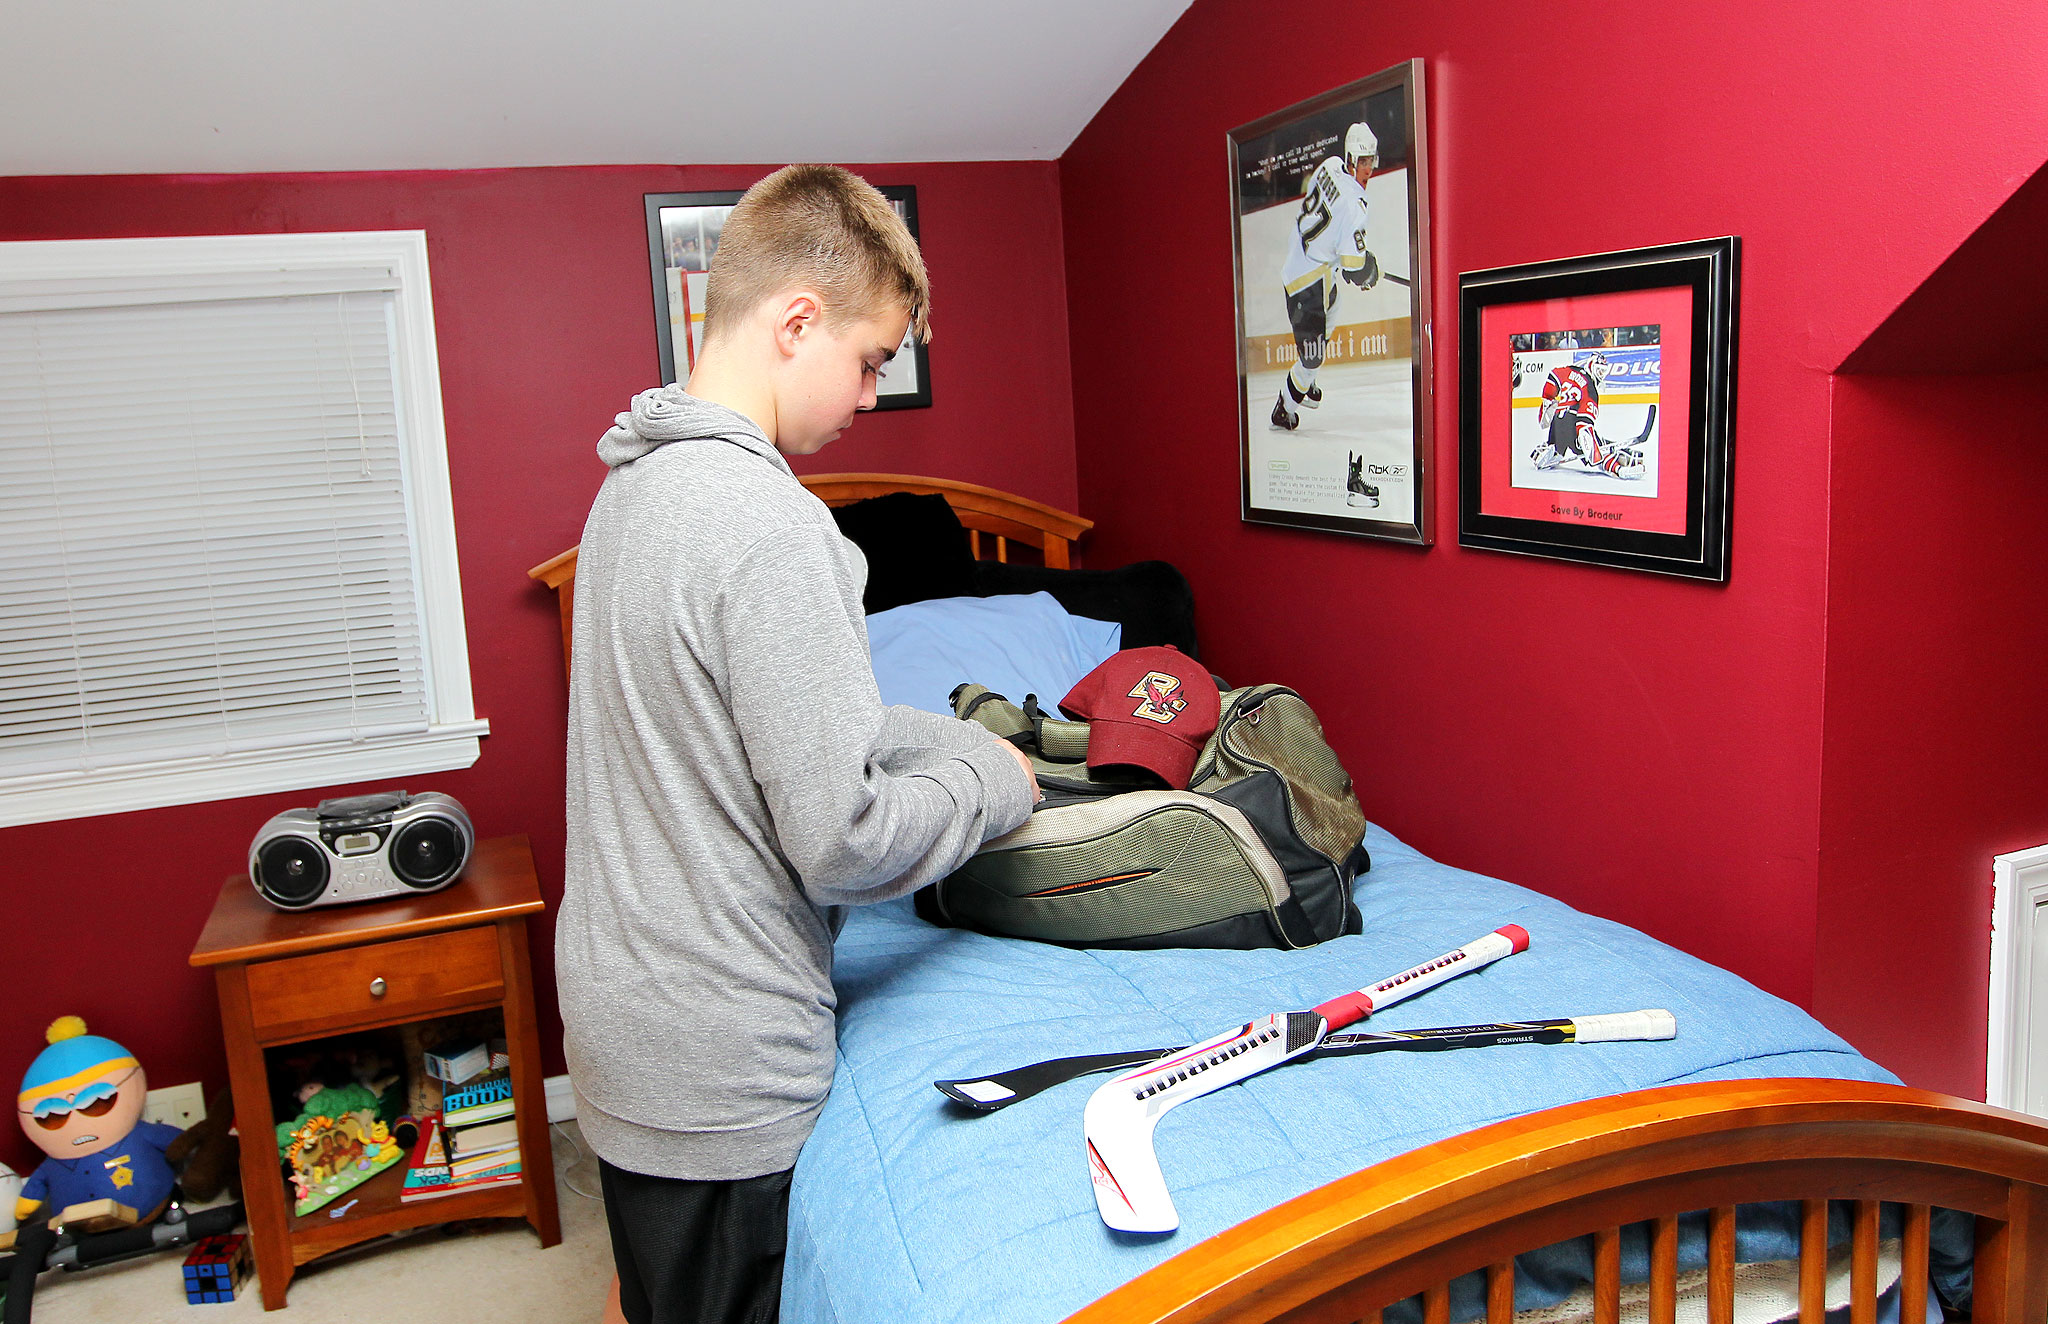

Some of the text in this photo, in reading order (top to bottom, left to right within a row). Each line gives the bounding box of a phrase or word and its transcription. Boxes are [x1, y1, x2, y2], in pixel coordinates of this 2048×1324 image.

[1317, 166, 1340, 207] CROSBY
[1266, 330, 1388, 364] i am what i am
[1551, 504, 1623, 521] Save By Brodeur
[1375, 951, 1467, 992] ARRIOR
[1496, 1035, 1534, 1044] STAMKOS
[1131, 1024, 1280, 1101] WARRIOR
[444, 1086, 513, 1112] BOON
